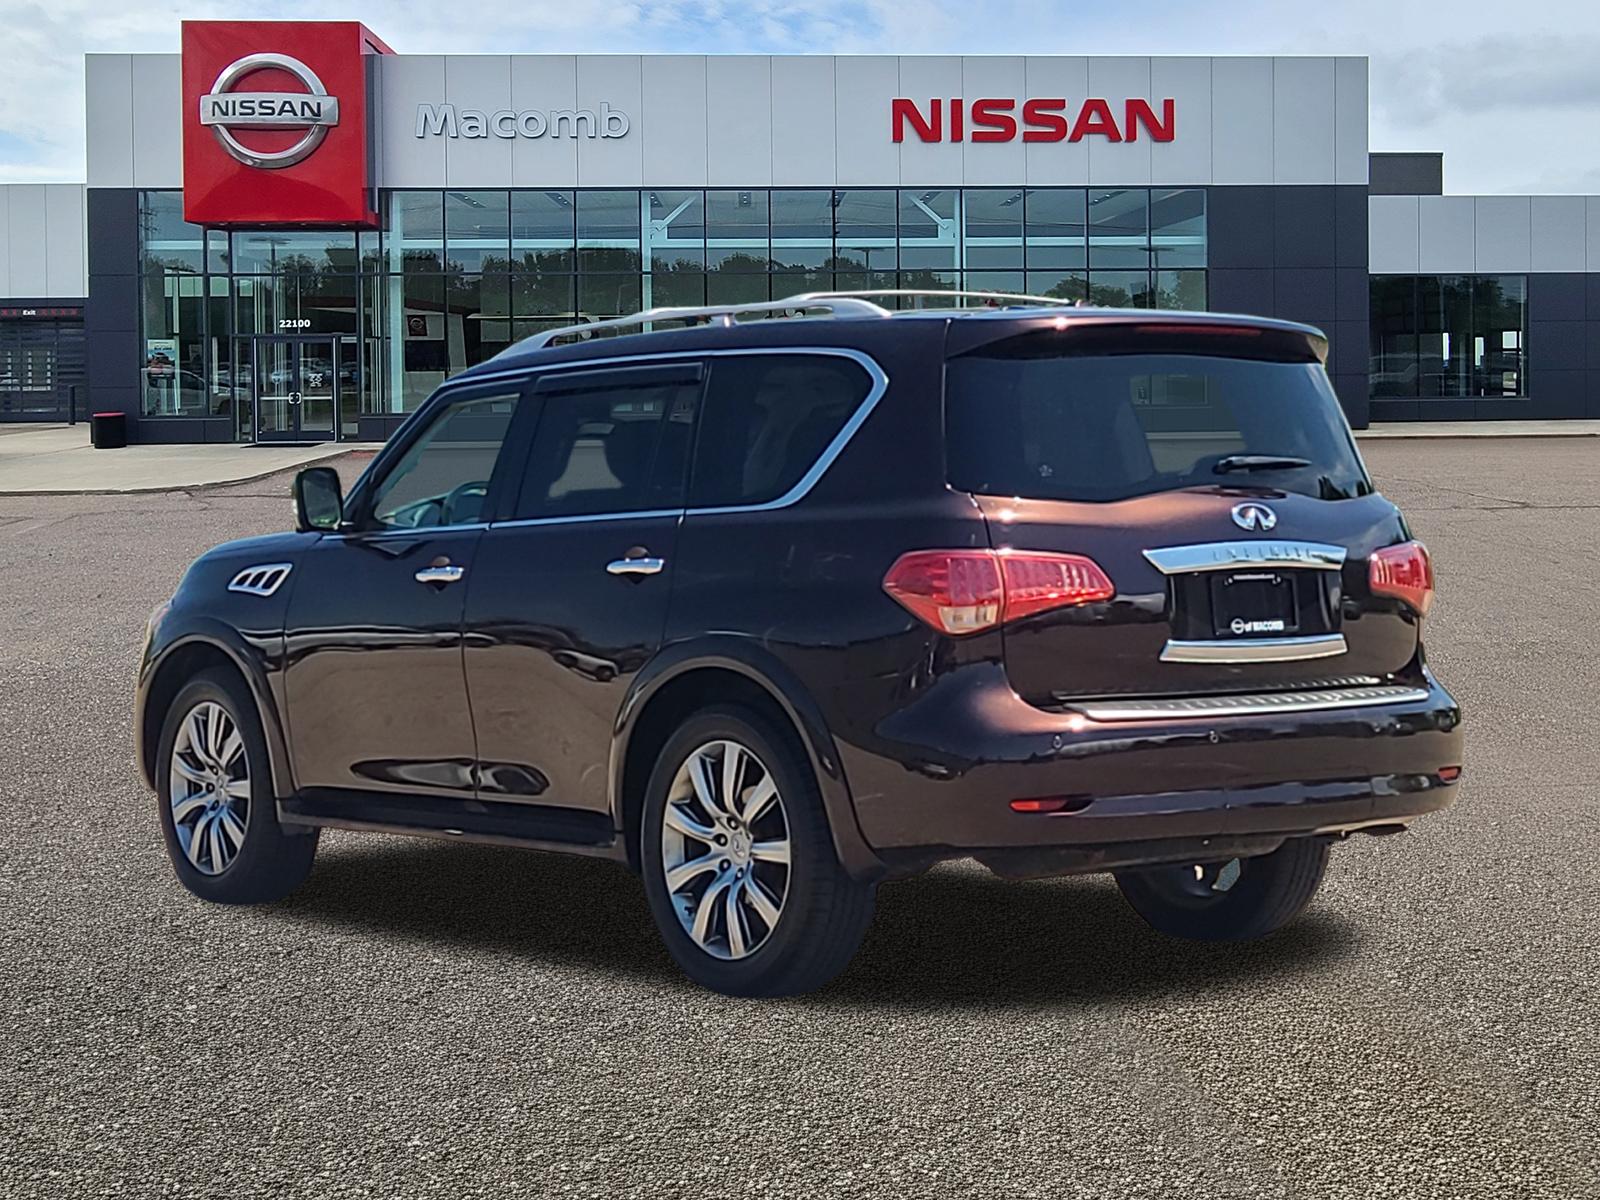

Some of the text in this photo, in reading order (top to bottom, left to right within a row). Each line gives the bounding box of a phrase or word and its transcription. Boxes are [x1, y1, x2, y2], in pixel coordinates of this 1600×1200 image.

[212, 100, 321, 118] NISSAN
[415, 102, 630, 138] Macomb
[892, 98, 1175, 143] NISSAN
[279, 319, 311, 328] 22100
